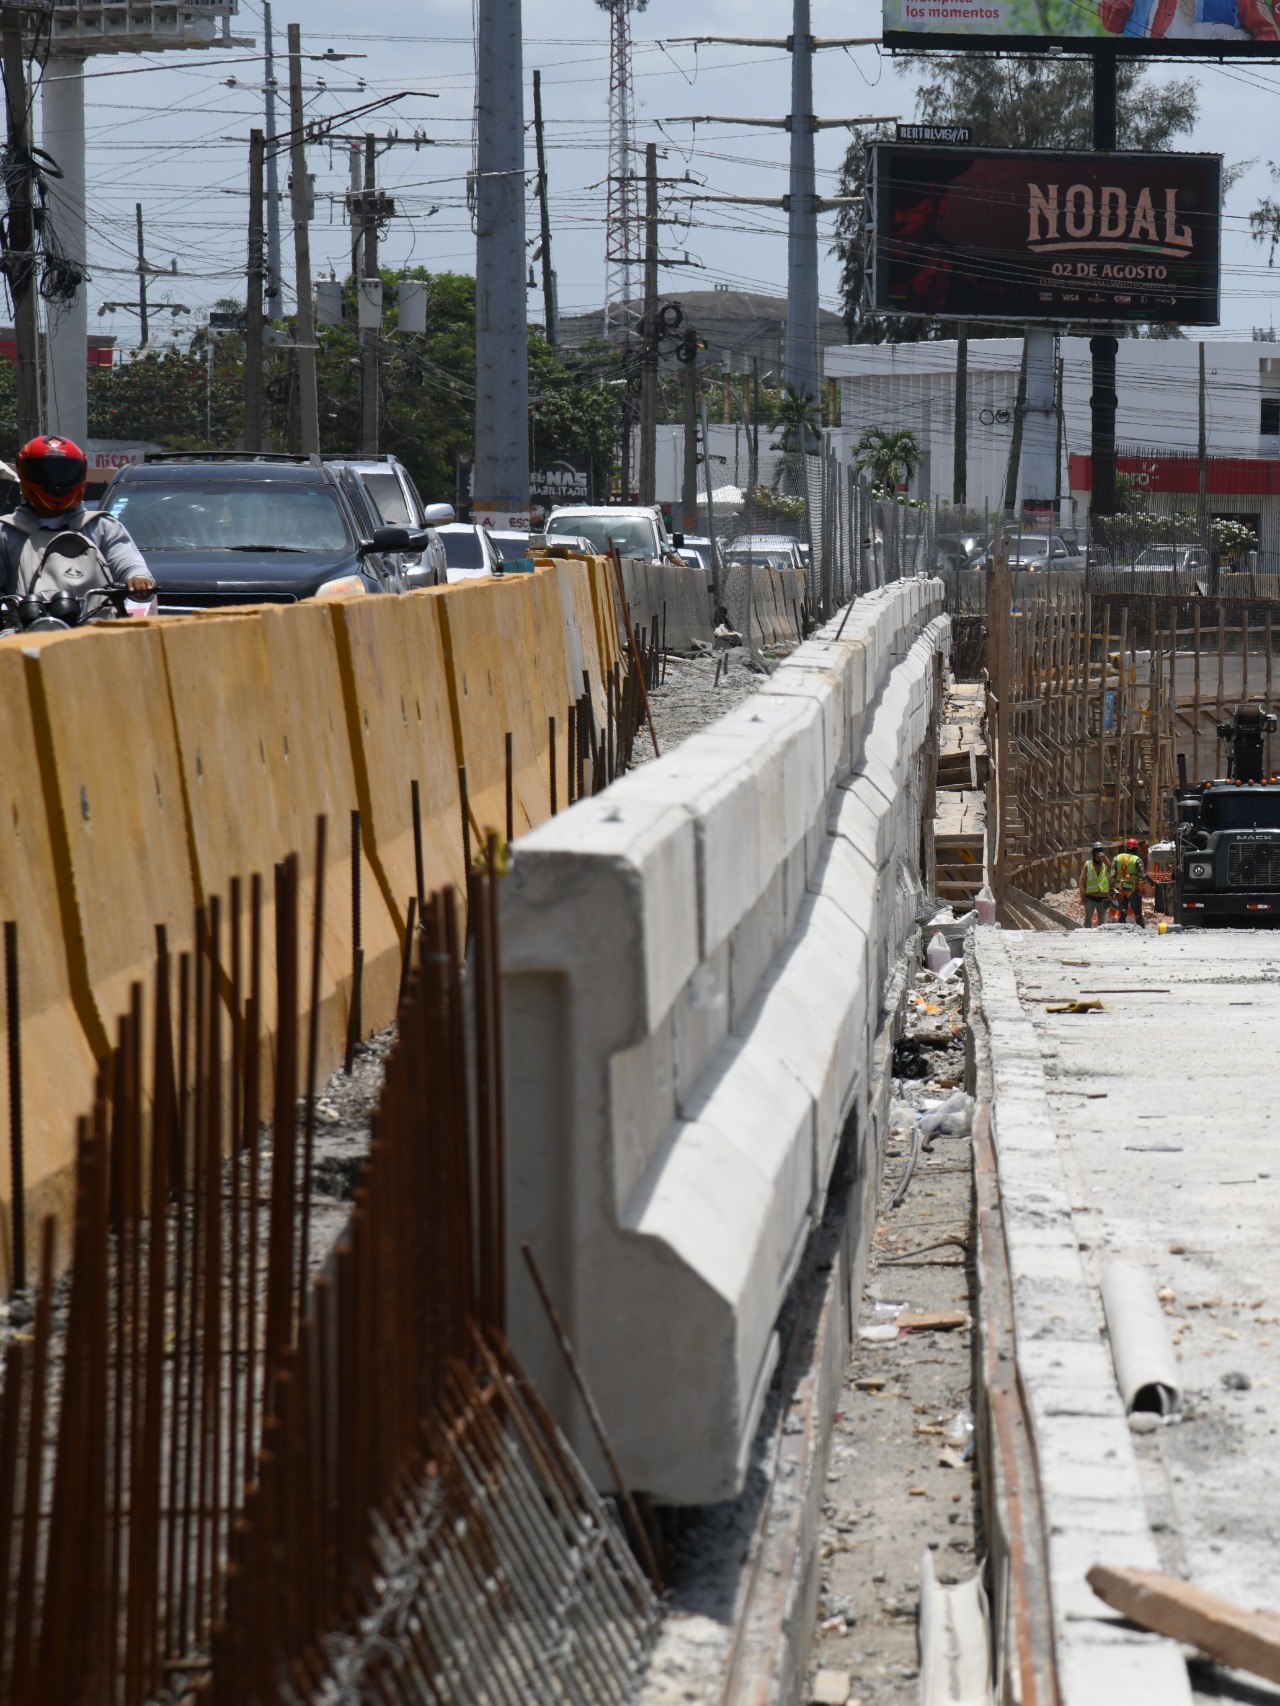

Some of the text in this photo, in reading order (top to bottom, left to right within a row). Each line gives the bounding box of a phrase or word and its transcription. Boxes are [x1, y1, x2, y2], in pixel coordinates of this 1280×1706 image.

[906, 6, 1000, 19] los momentos
[1026, 182, 1194, 248] NODAL
[1052, 263, 1168, 279] 02 DE AGOSTO
[1062, 293, 1080, 301] VISA
